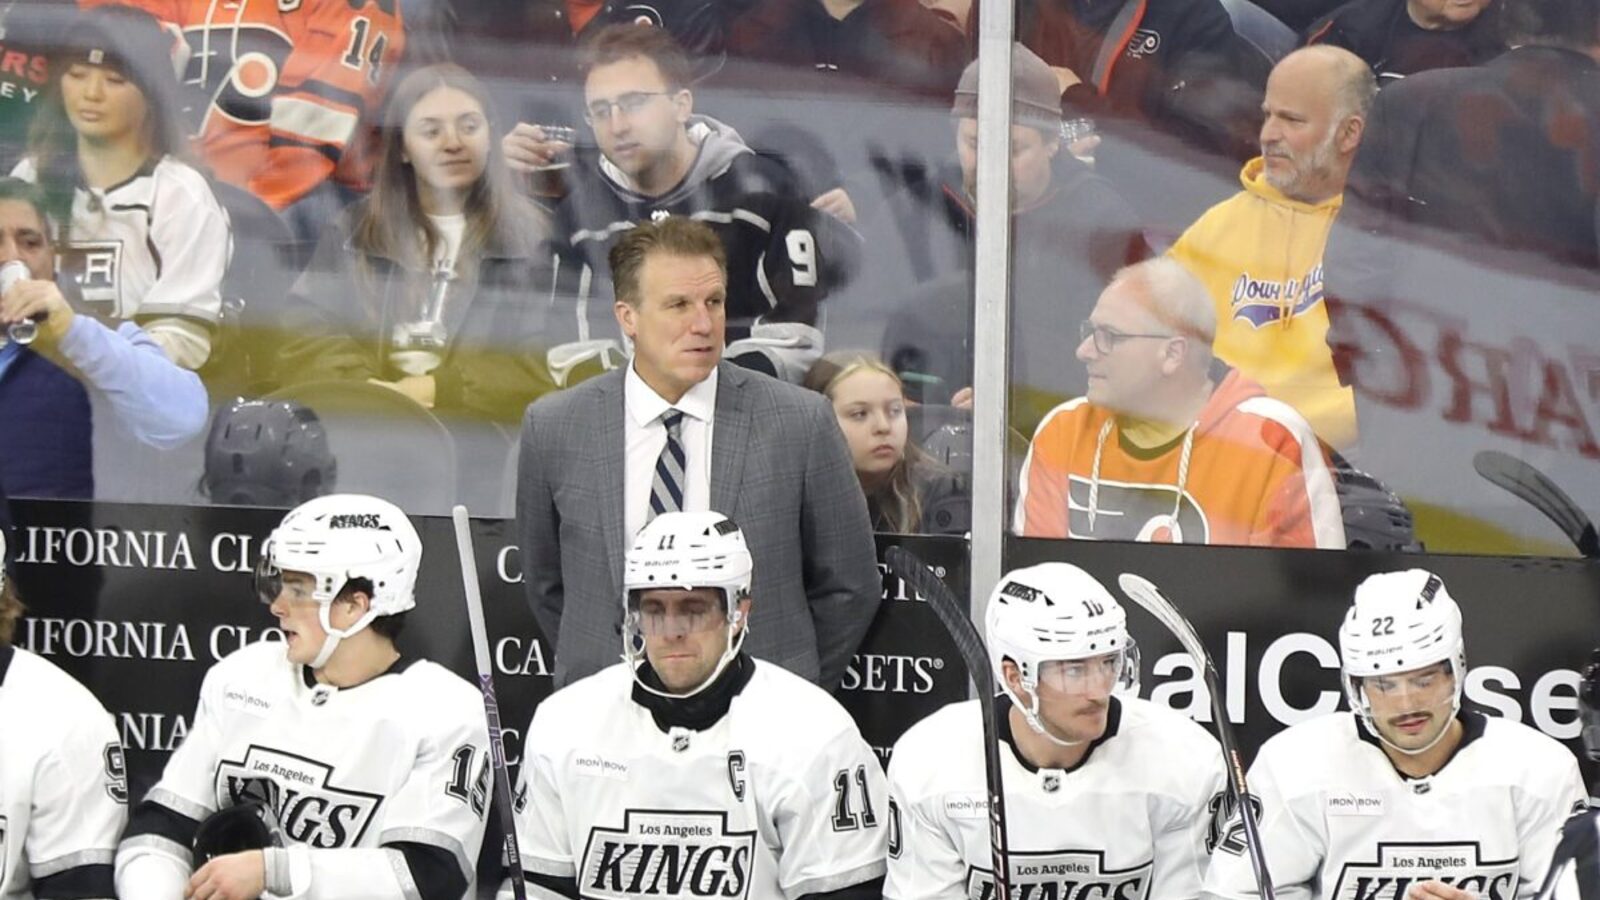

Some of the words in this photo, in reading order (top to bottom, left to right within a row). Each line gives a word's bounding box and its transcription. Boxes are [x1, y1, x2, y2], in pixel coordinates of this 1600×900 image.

[0, 49, 49, 85] RS
[785, 229, 818, 287] 9
[658, 534, 676, 550] 11
[20, 617, 196, 661] IFORNIA
[1371, 616, 1396, 636] 22
[253, 760, 270, 772] Los
[270, 763, 316, 787] Angeles
[727, 750, 746, 802] C
[831, 764, 878, 833] 11
[1328, 798, 1354, 807] IRON
[1357, 798, 1382, 807] BOW
[639, 824, 661, 836] Los
[663, 824, 713, 838] Angeles
[591, 841, 750, 898] KINGS
[1016, 865, 1039, 876] Los
[1041, 863, 1090, 877] Angeles
[1392, 857, 1415, 868] Los
[1416, 857, 1467, 870] Angeles
